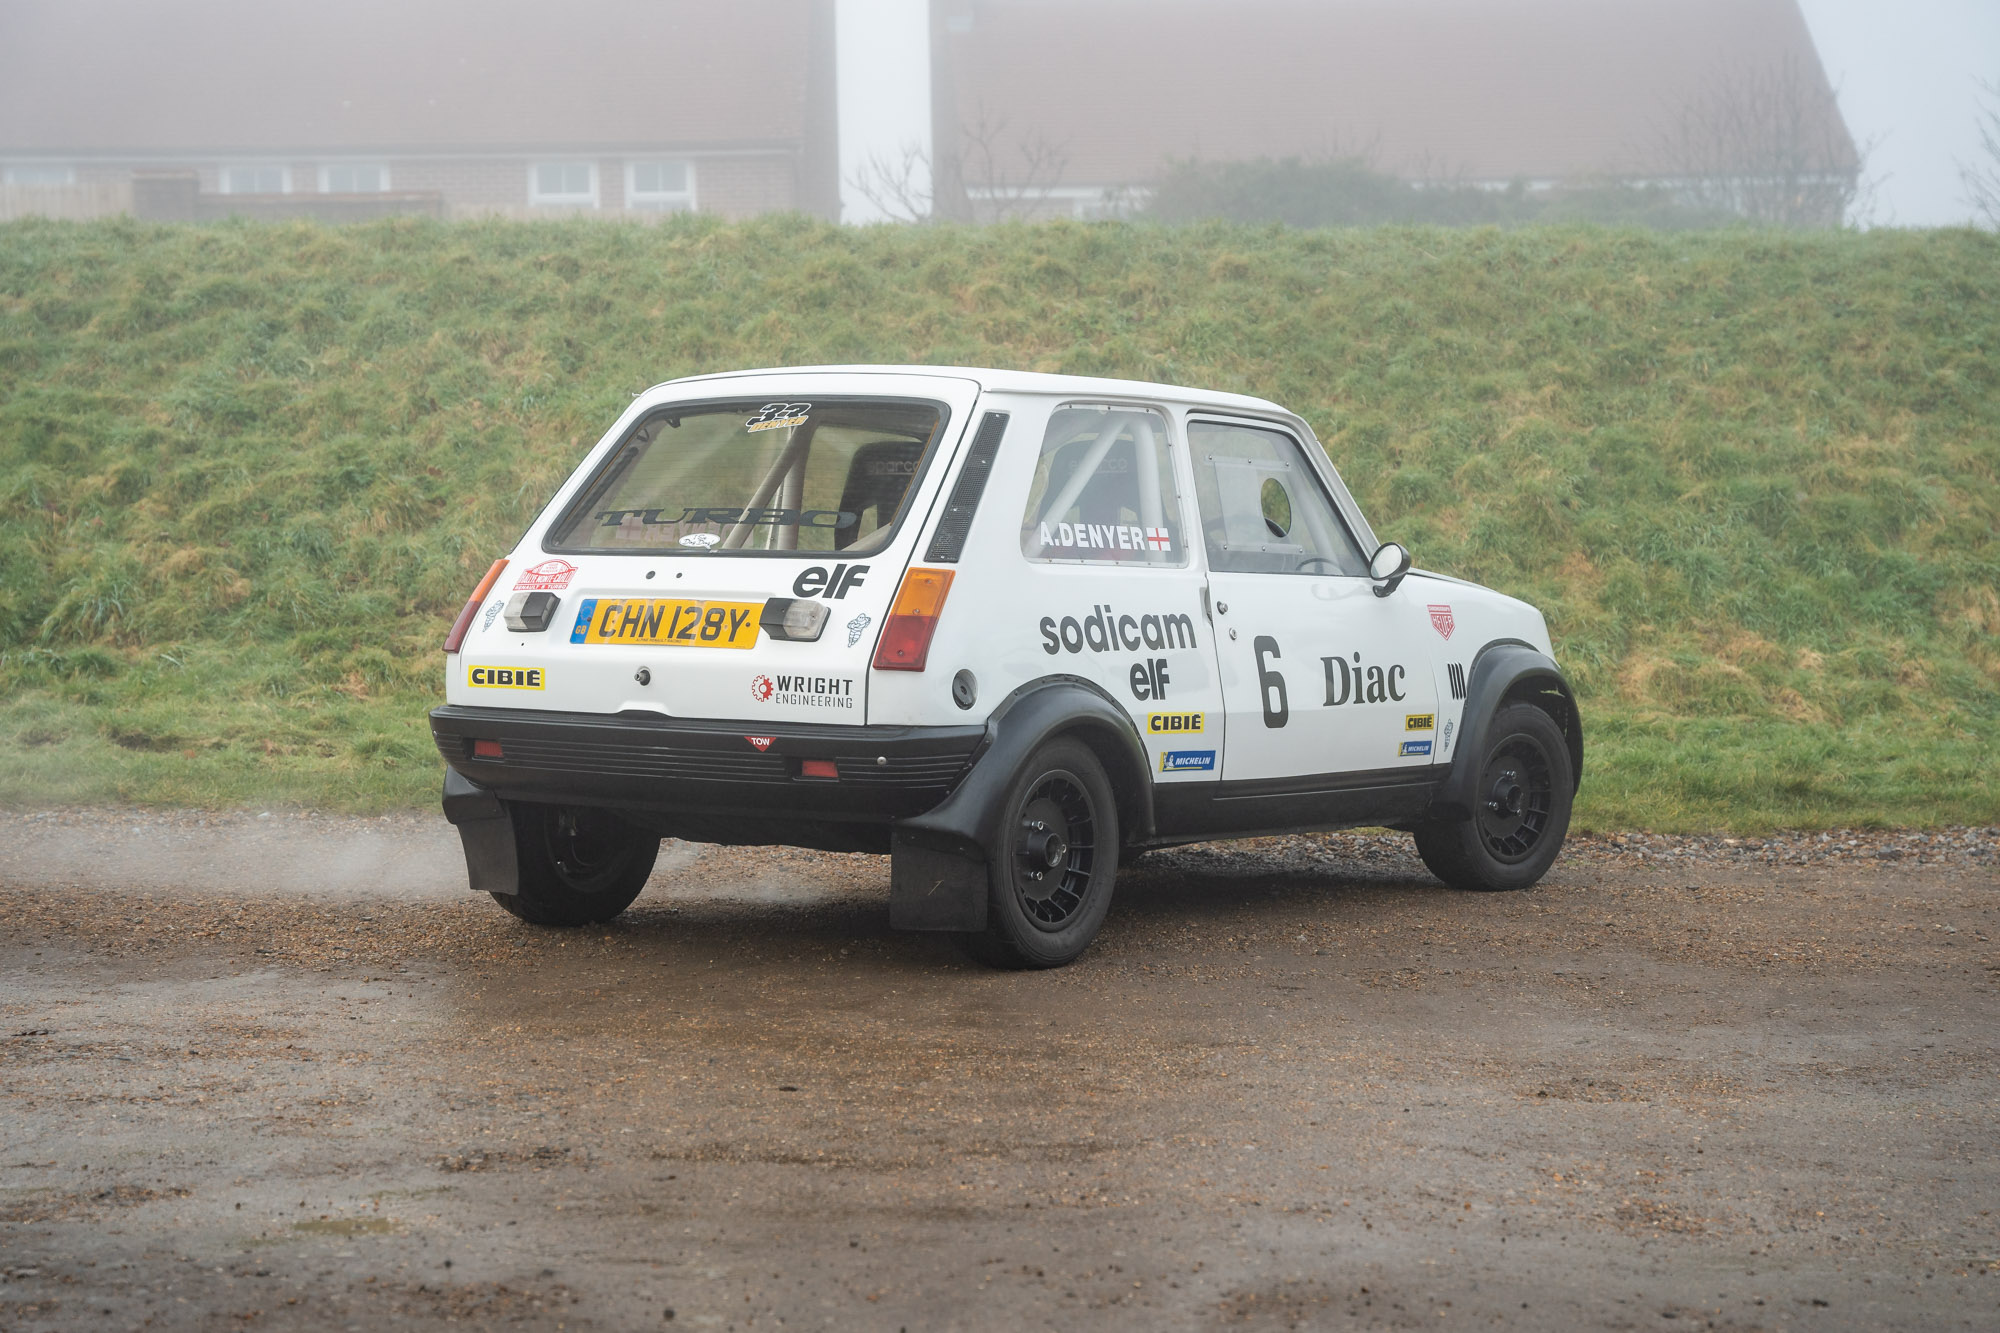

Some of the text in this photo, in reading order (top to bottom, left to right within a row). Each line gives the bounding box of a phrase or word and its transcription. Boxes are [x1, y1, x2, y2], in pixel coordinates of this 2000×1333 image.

[595, 508, 857, 529] TURBO
[1040, 521, 1145, 550] A.DENYER
[793, 564, 871, 600] elf
[575, 625, 587, 634] GB
[599, 604, 750, 642] CHN 128Y
[1040, 605, 1197, 655] sodicam
[1432, 615, 1454, 635] HEUER
[777, 675, 853, 695] WRIGHT
[1130, 658, 1170, 701] elf
[1254, 636, 1288, 728] 6
[1320, 651, 1406, 706] Diac
[776, 693, 853, 708] ENGINEERING
[751, 737, 770, 745] TOW
[1175, 756, 1211, 766] MICHELIN
